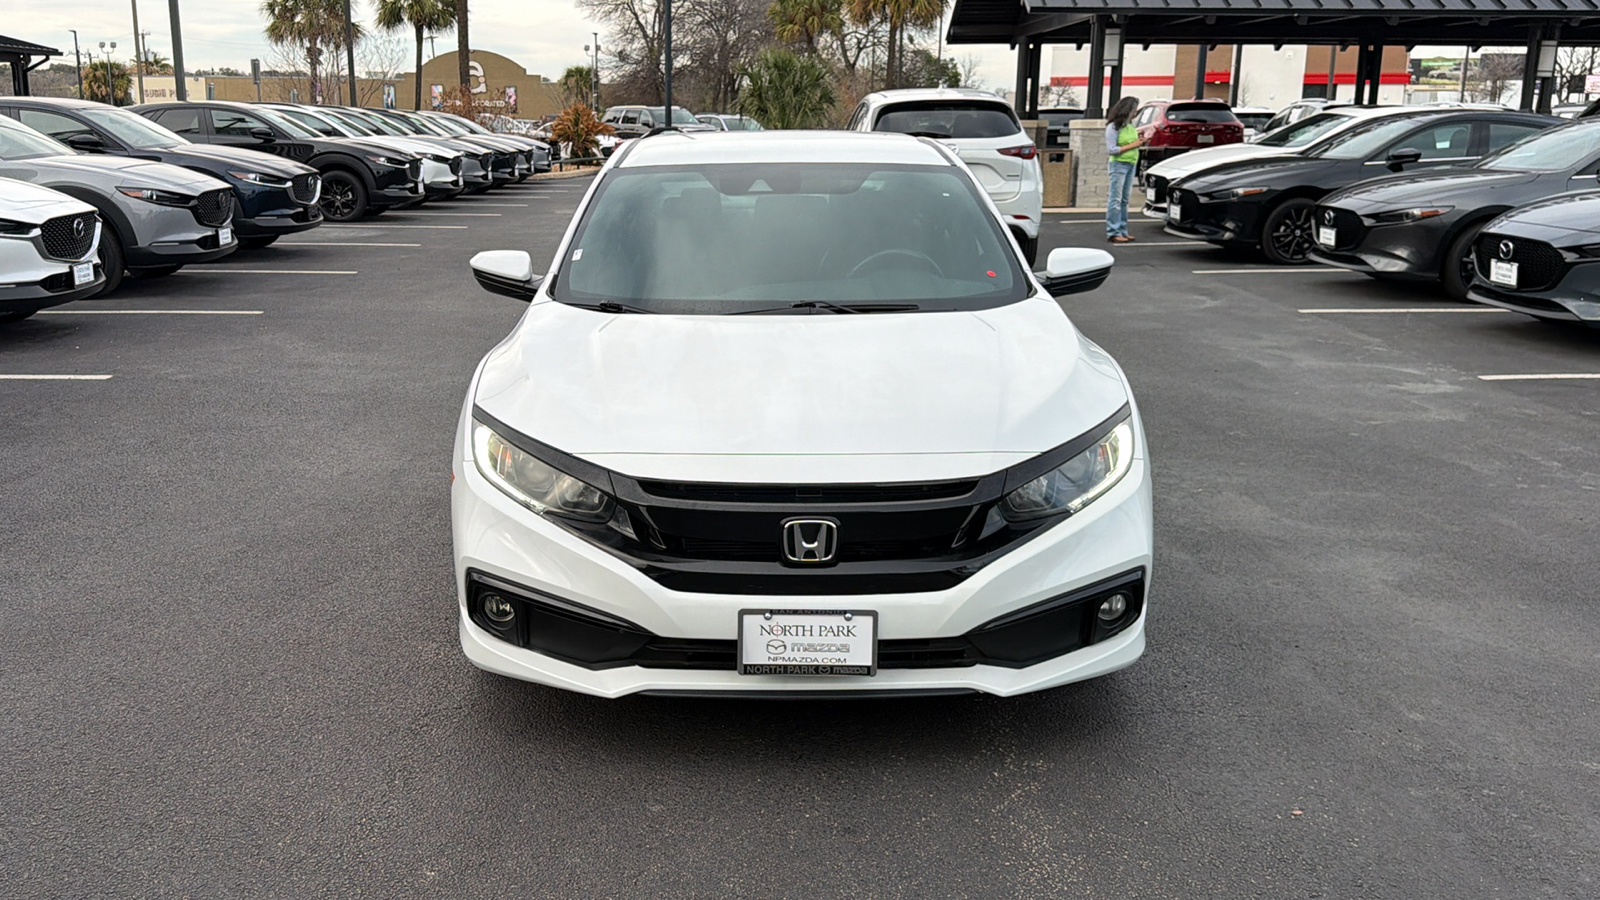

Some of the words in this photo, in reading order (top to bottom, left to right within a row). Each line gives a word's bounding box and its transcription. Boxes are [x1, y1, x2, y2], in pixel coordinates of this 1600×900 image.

[759, 624, 814, 638] NORTH
[818, 624, 857, 638] PARK
[791, 642, 850, 653] mazda
[767, 656, 847, 664] NPMAZDA.COM
[746, 665, 783, 674] NORTH
[787, 666, 816, 674] PARK
[833, 666, 868, 674] mazda
